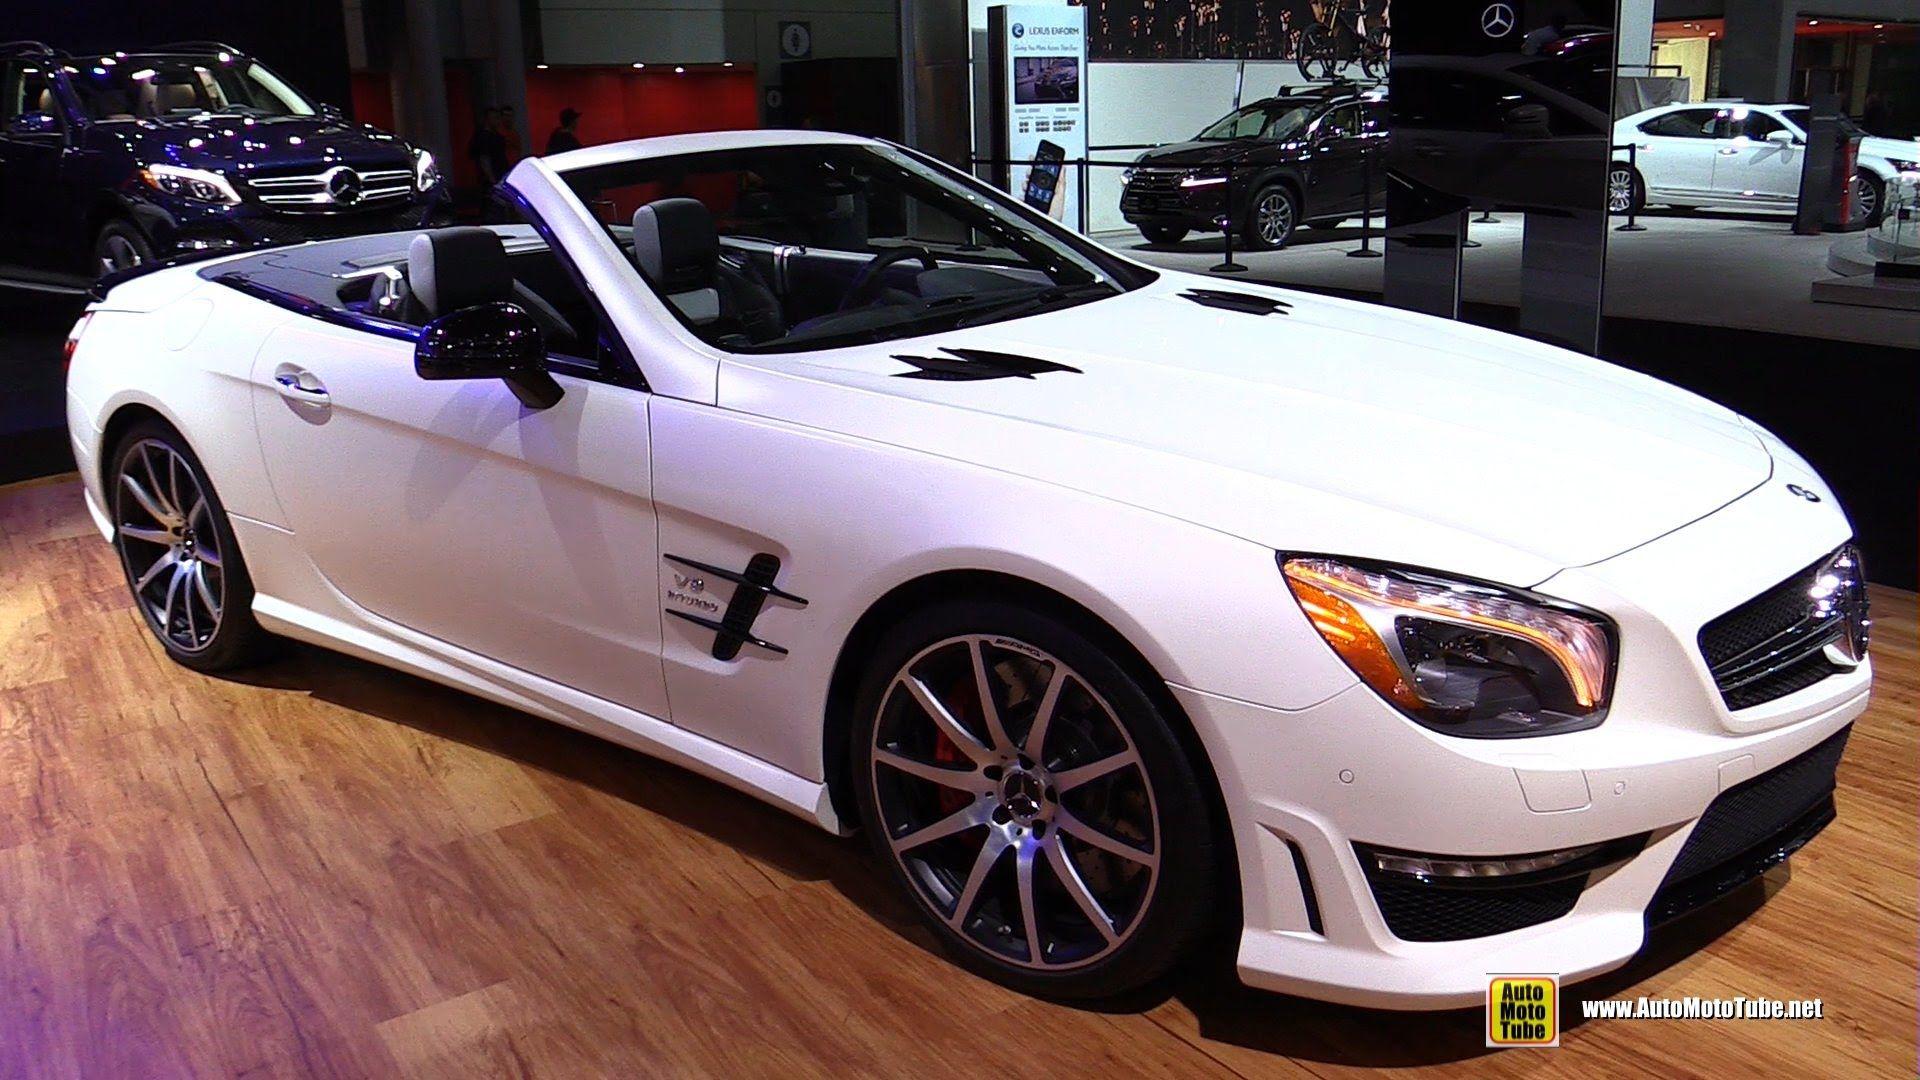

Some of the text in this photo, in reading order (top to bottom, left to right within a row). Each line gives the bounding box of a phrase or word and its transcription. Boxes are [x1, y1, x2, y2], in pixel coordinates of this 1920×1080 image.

[1029, 26, 1080, 36] LEXUS ENFORM
[674, 574, 705, 593] V8
